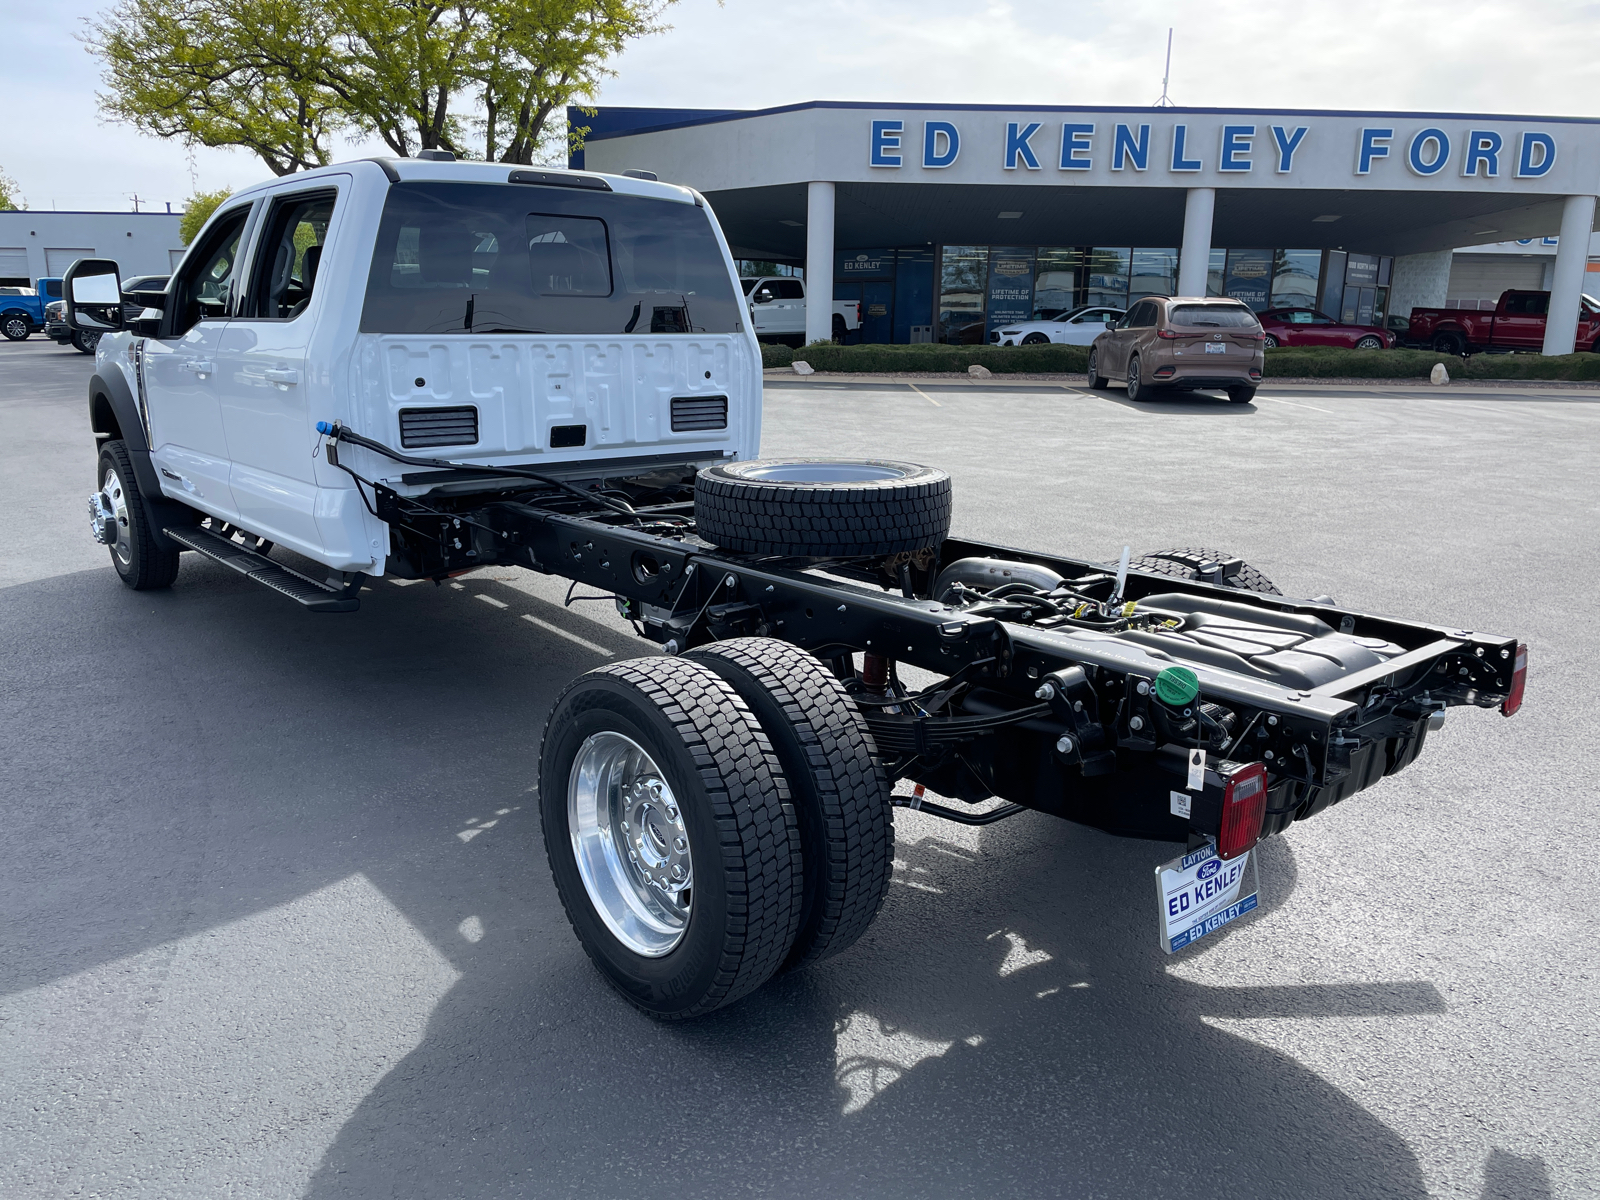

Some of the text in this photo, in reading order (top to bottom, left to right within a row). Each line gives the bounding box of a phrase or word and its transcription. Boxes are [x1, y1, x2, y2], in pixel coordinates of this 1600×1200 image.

[869, 119, 1557, 179] ED KENLEY FORD
[844, 261, 881, 270] ED KENLEY
[1169, 675, 1187, 689] DIESEL
[1183, 846, 1213, 868] LAYTON,
[1200, 862, 1219, 879] Ford
[1168, 860, 1245, 917] ED KENLEY
[1189, 924, 1203, 942] ED
[1205, 903, 1242, 933] KENLEY
